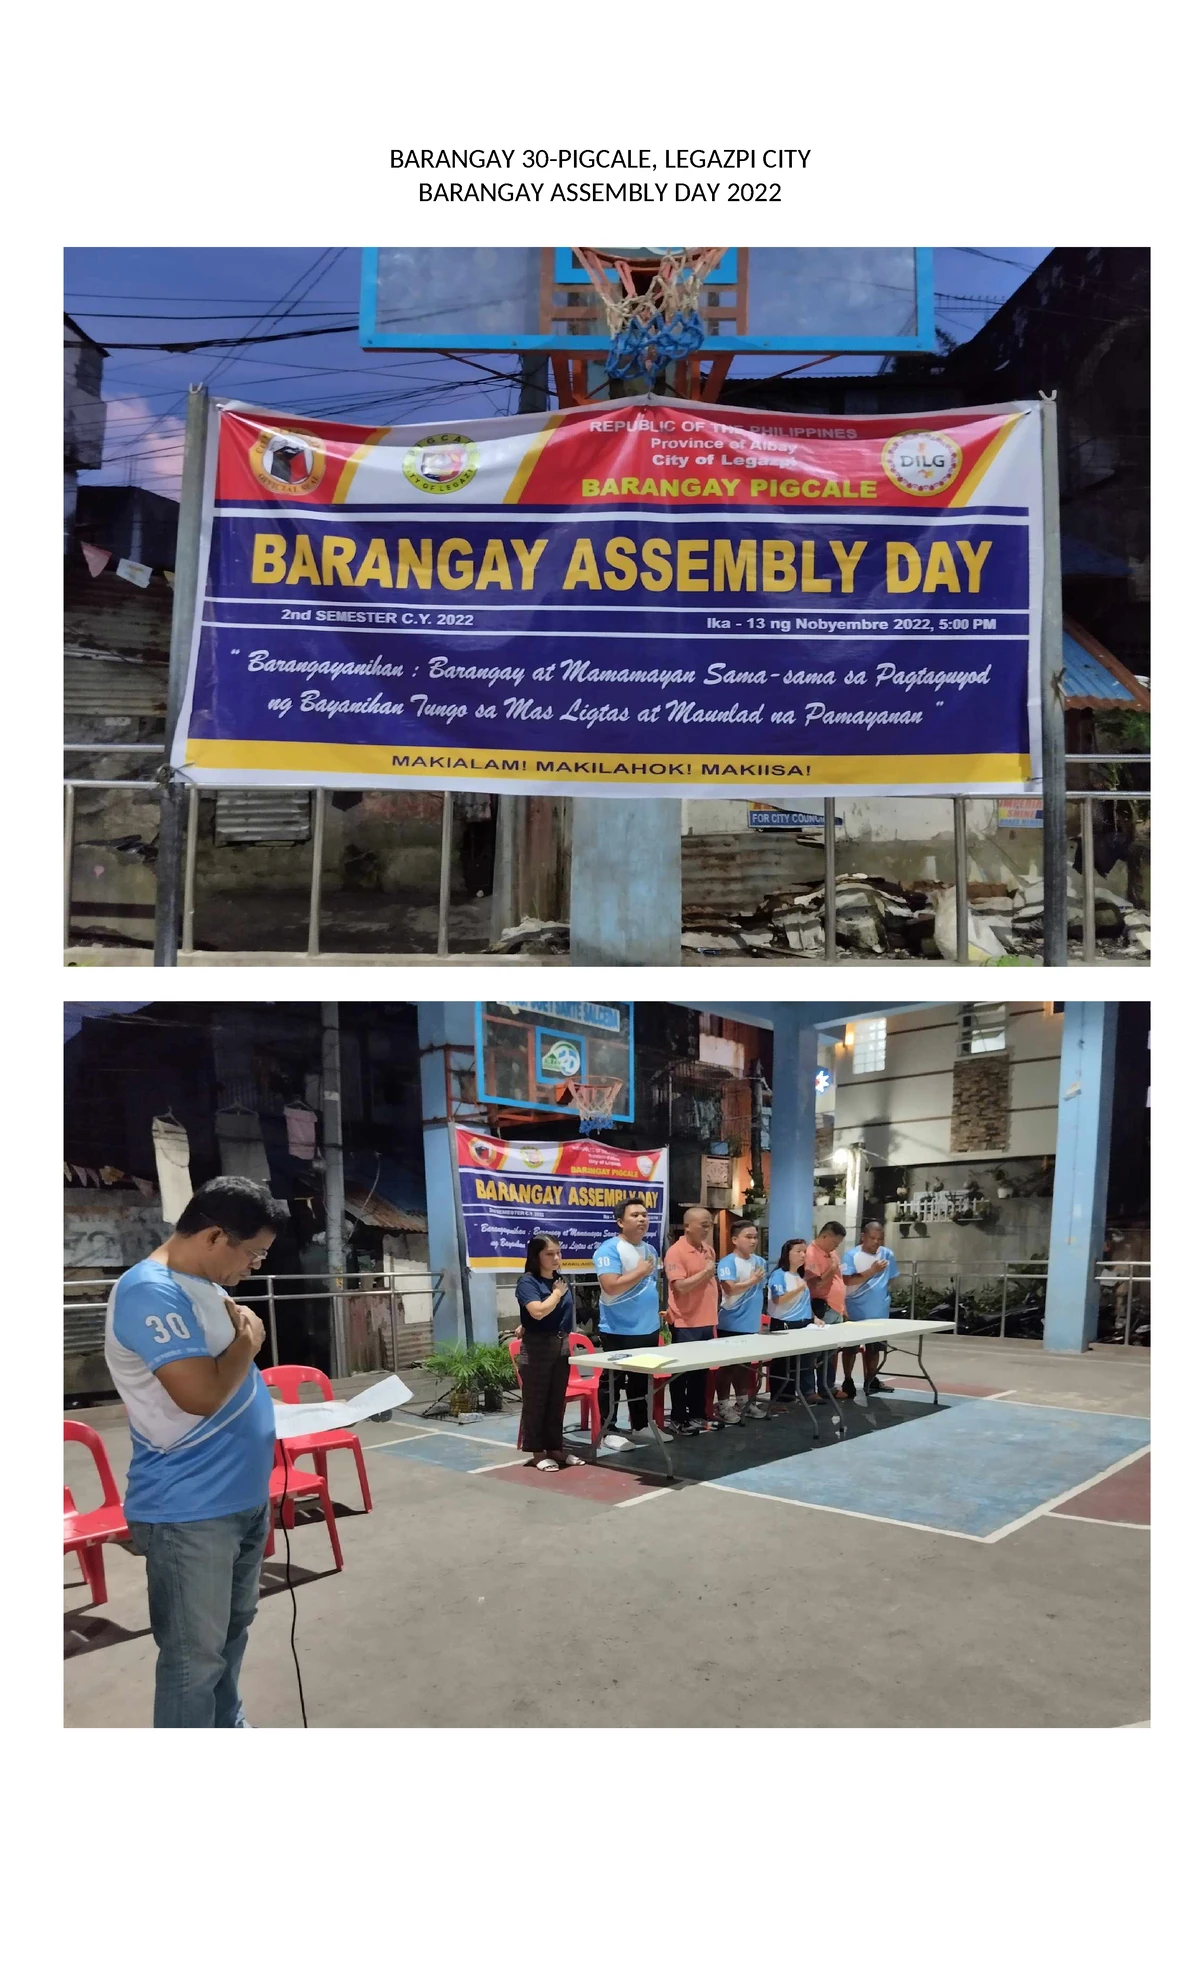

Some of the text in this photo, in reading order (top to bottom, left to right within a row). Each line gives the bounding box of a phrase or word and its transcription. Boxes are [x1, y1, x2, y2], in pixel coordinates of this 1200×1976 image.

[589, 420, 858, 439] REPUBLIC OF THE PHILIPPINES
[651, 437, 799, 455] Province of Albay
[652, 453, 798, 469] City of Legazpi
[899, 454, 945, 468] DILG
[423, 482, 436, 491] OF
[581, 478, 877, 499] BARANGAY PIGCALE
[251, 533, 993, 594] BARANGAY ASSEMBLY DAY
[281, 608, 474, 627] 2nd SEMESTER C.Y. 2022
[706, 617, 731, 629] Ika
[747, 617, 766, 629] 13
[770, 621, 791, 633] ng
[795, 617, 889, 633] Nobyembre
[893, 617, 934, 632] 2022,
[938, 617, 969, 630] 5:00
[972, 618, 997, 631] PM
[247, 650, 404, 681] Barangayanihan
[428, 656, 525, 687] Barangay
[532, 666, 555, 682] at
[560, 659, 696, 691] Mamamayan
[703, 663, 836, 687] Sama-sama
[844, 673, 867, 686] sa
[875, 664, 993, 692] Pagtaguyod
[267, 698, 293, 714] ng
[299, 690, 404, 719] Bayanihan
[410, 694, 468, 724] Tungo
[474, 704, 497, 720] sa
[503, 697, 554, 723] Mas
[559, 698, 631, 729] Ligtas
[637, 705, 661, 722] at
[665, 699, 764, 725] Maunlad
[770, 709, 797, 724] na
[804, 702, 924, 731] Pamayanan
[391, 755, 812, 778] MAKIALAM! MAKILAHOK! MAKIISA!
[751, 813, 770, 823] FOR
[771, 813, 790, 823] CITY
[475, 1179, 564, 1206] BARANGAY
[597, 1256, 611, 1267] 30
[720, 1266, 731, 1277] 30
[145, 1312, 191, 1344] 30
